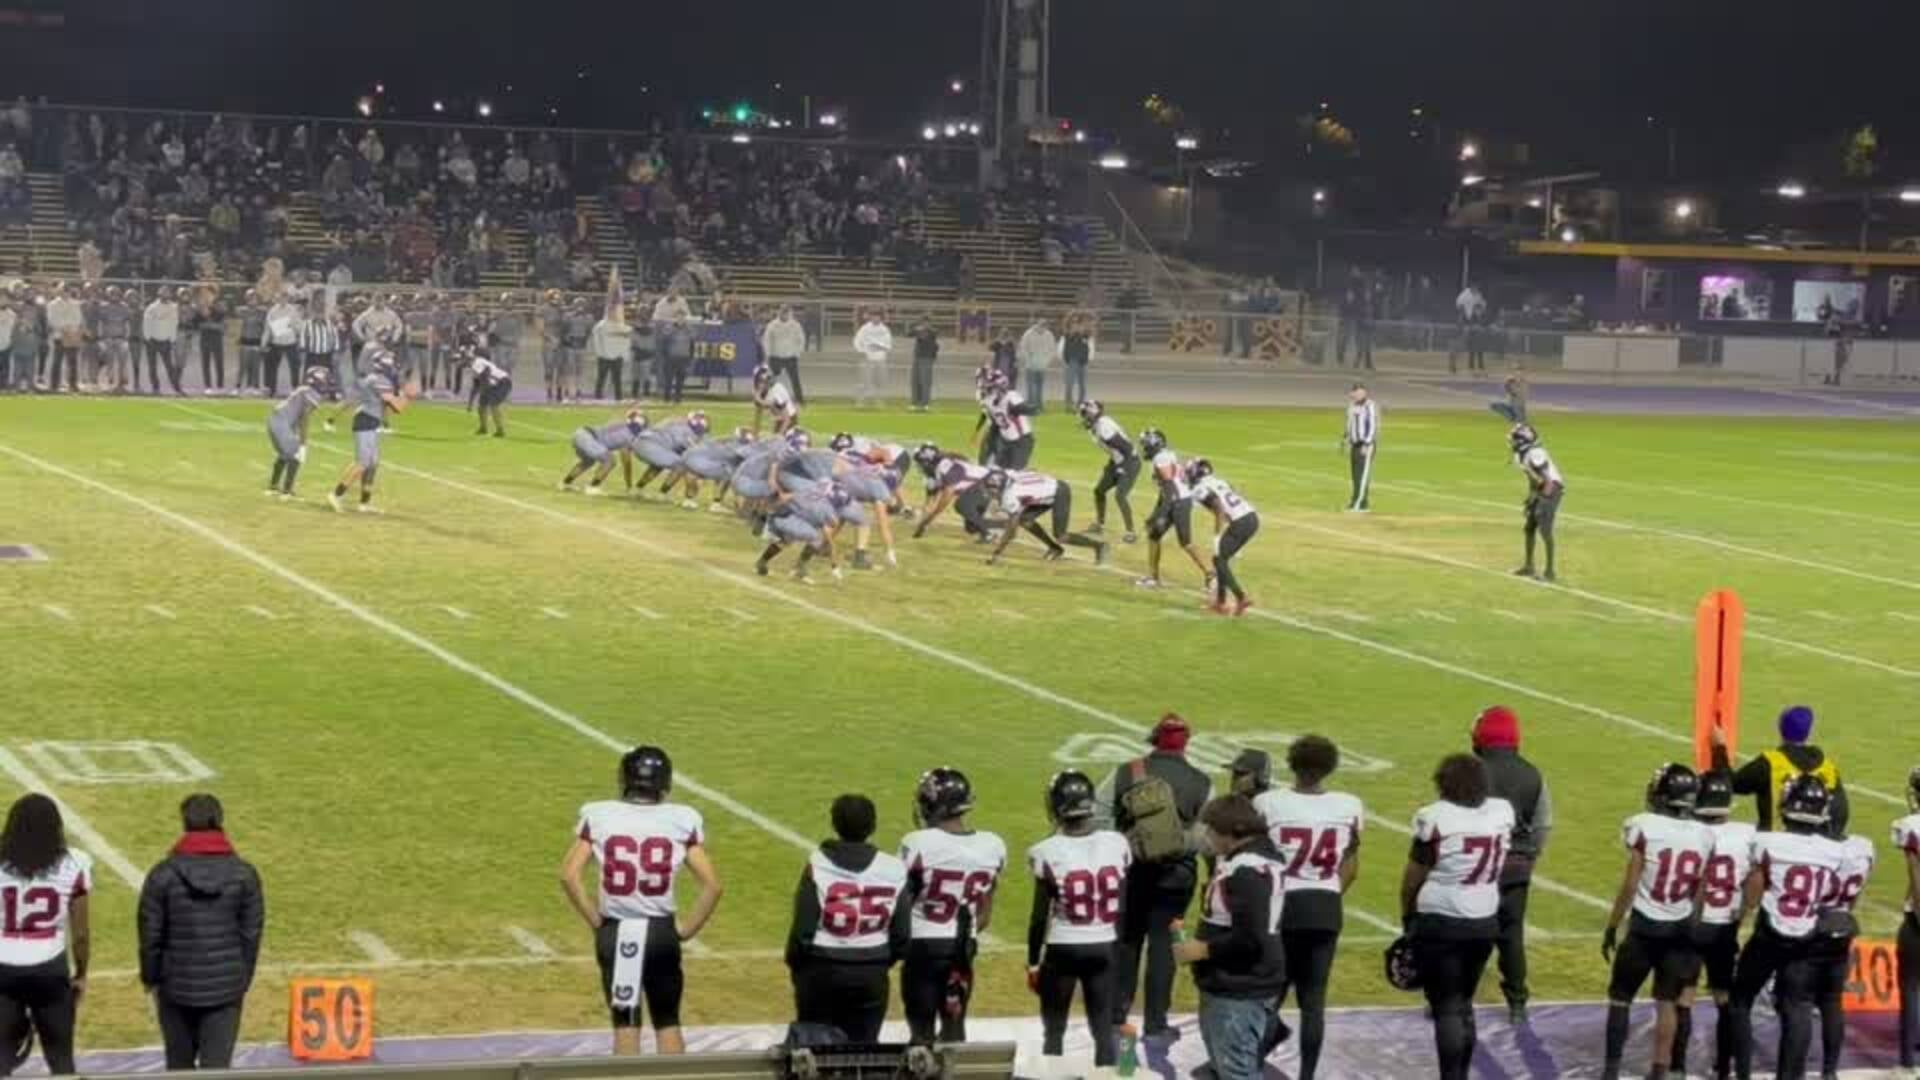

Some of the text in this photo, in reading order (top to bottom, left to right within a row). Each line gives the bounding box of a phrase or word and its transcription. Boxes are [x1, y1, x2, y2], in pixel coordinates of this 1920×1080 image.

[602, 834, 673, 897] 69
[1279, 827, 1338, 881] 74
[1, 885, 61, 940] 12
[821, 881, 896, 938] 65
[1063, 865, 1121, 927] 88
[300, 984, 364, 1052] 50
